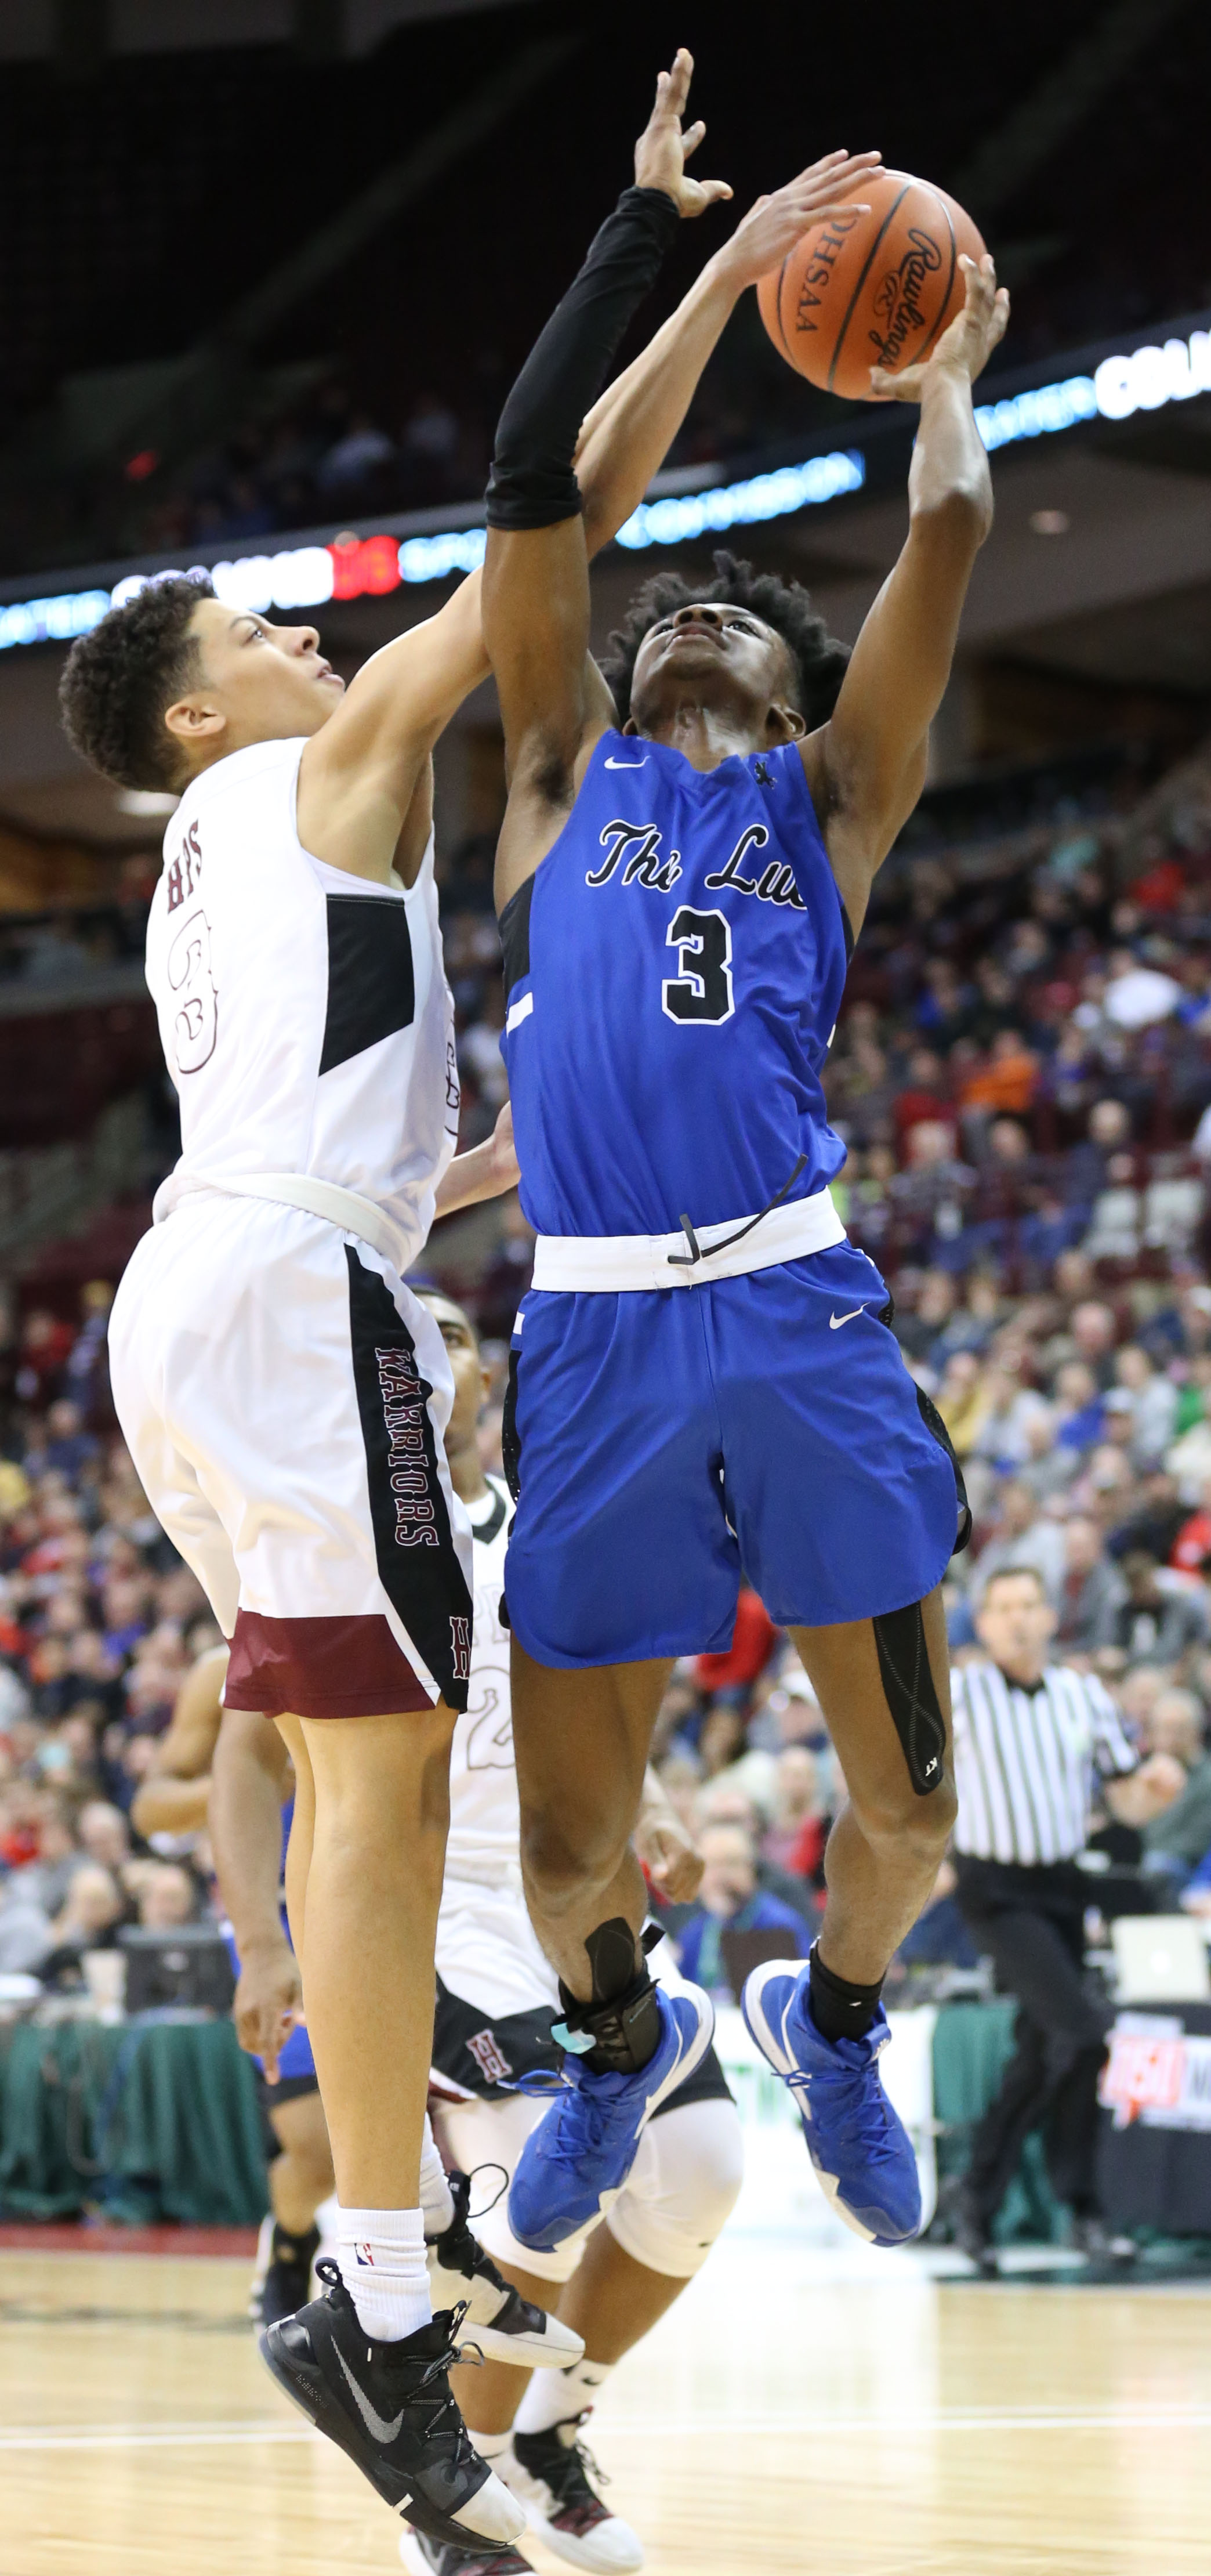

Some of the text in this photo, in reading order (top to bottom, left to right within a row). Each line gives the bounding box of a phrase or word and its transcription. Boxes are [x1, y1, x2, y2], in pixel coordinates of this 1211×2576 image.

[868, 228, 942, 367] Rawlings
[661, 905, 735, 1026] 3
[374, 1346, 440, 1547] WARRIORS
[449, 1616, 471, 1680] H
[465, 2028, 513, 2084] H
